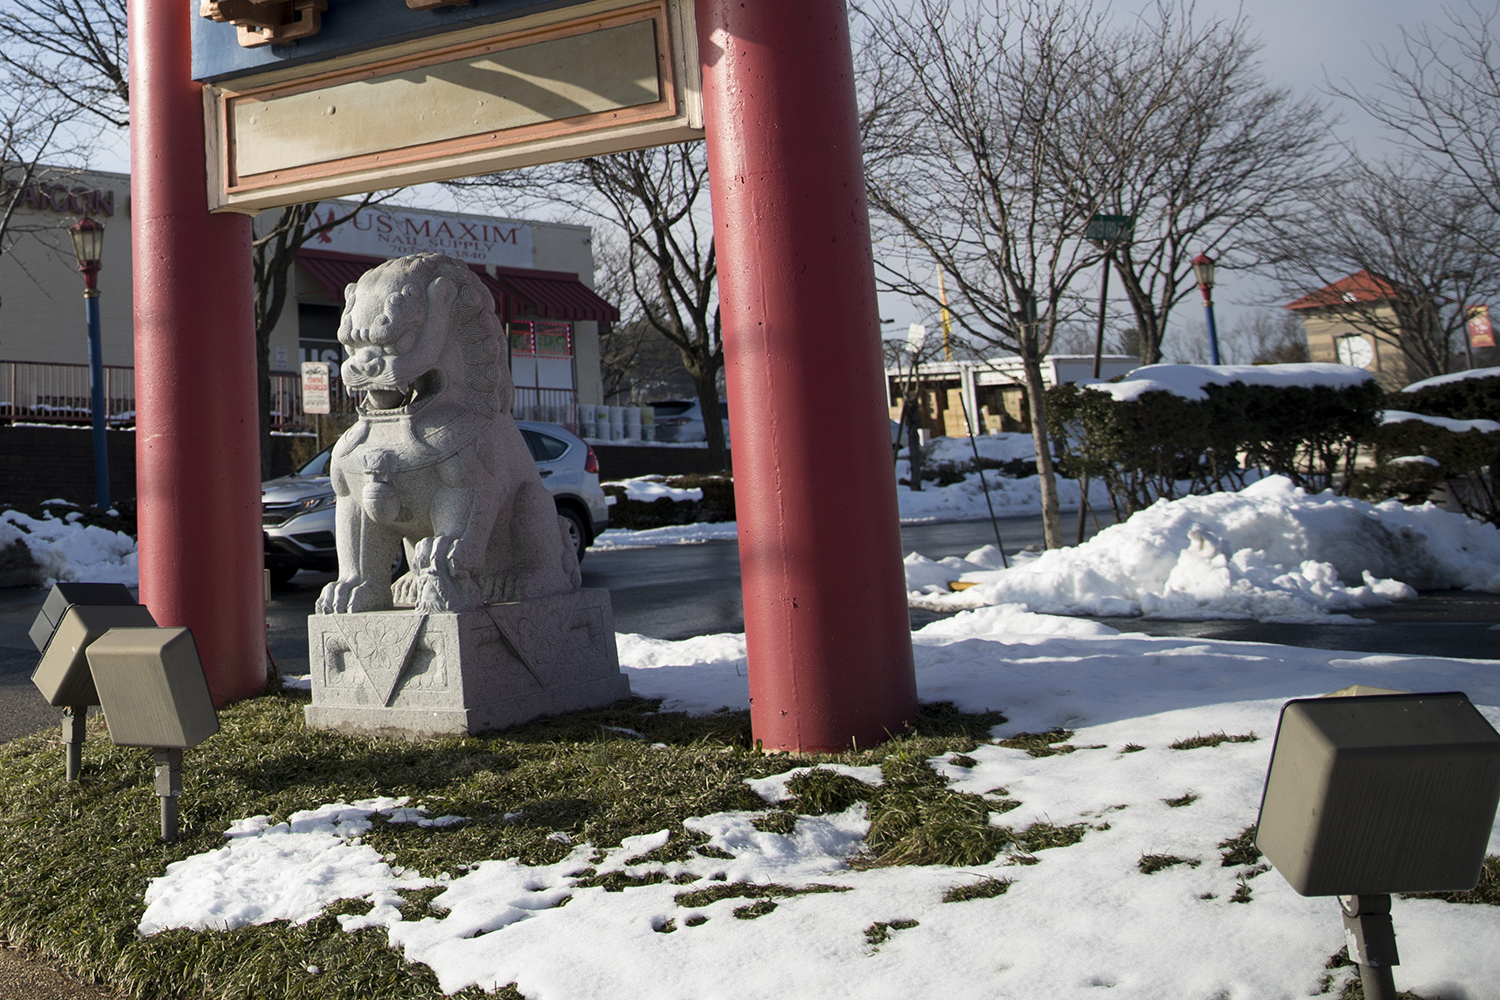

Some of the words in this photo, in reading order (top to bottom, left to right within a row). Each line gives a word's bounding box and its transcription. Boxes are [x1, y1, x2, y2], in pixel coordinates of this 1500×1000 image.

[4, 180, 115, 217] SAIGON
[352, 212, 393, 234] US
[404, 217, 518, 245] MAXIM
[377, 233, 424, 247] NAIL
[428, 237, 495, 253] SUPPLY
